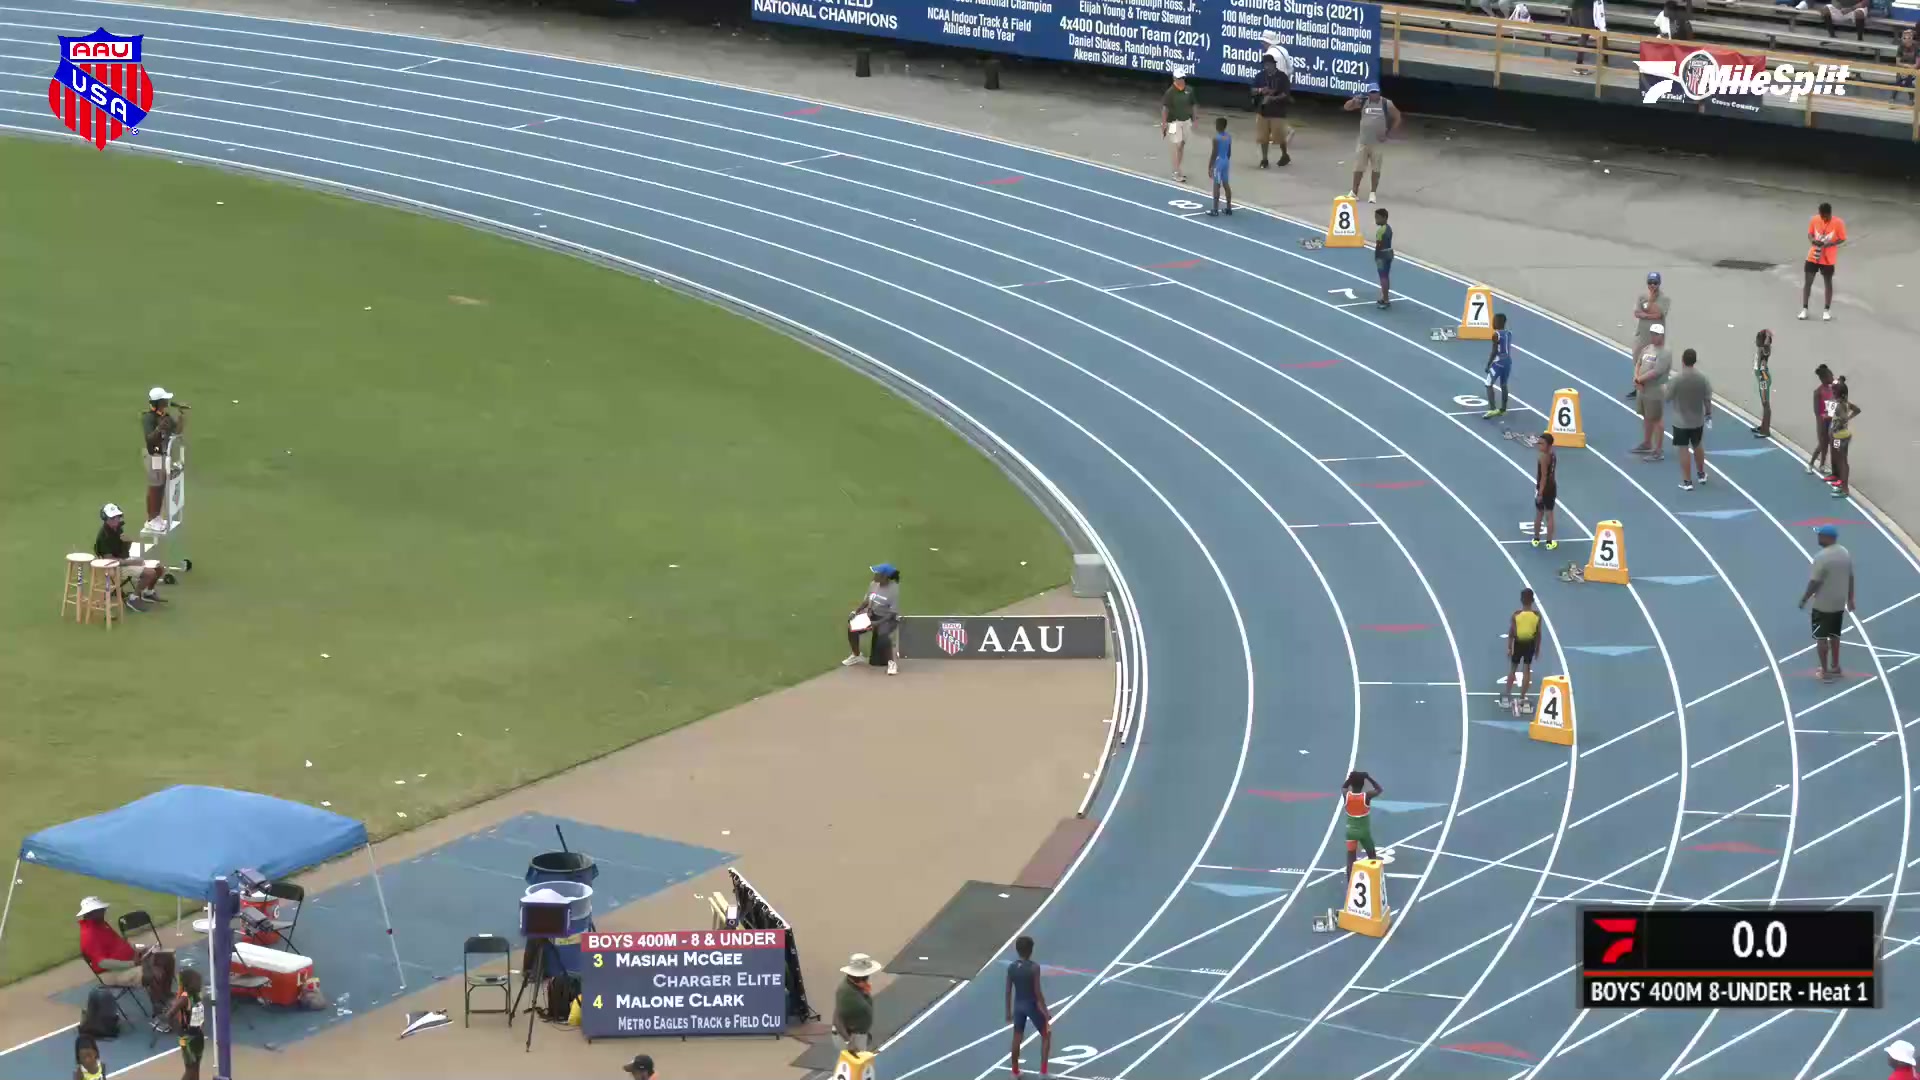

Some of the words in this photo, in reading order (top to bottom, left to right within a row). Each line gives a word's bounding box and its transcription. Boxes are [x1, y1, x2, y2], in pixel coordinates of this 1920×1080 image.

[754, 1, 816, 19] NATIONAL
[819, 7, 898, 29] CHAMPIONS
[1010, 0, 1052, 13] Champion
[1079, 1, 1101, 16] Elijah
[1102, 4, 1125, 20] Young
[1127, 7, 1134, 19] &
[1135, 8, 1160, 22] Trevor
[1162, 11, 1191, 26] Stewart
[1284, 0, 1324, 17] Sturgis
[1326, 3, 1364, 24] (2021)
[927, 7, 950, 21] NCAA
[951, 10, 977, 25] Indoor
[979, 14, 1000, 28] Track
[1002, 17, 1009, 29] &
[1011, 18, 1032, 32] Field
[1222, 10, 1237, 23] 100
[1239, 12, 1261, 26] Meter
[1263, 15, 1294, 30] Outdoor
[1296, 19, 1329, 34] National
[1331, 23, 1372, 40] Champion
[943, 22, 971, 36] Athlete
[972, 26, 981, 38] of
[982, 27, 995, 39] the
[997, 29, 1015, 42] Year
[1060, 16, 1092, 33] 4x400
[1095, 21, 1138, 38] Outdoor
[1140, 26, 1171, 43] Team
[1174, 30, 1211, 51] (2021)
[1221, 25, 1237, 38] 200
[1296, 34, 1329, 49] National
[1331, 38, 1371, 55] Champion
[1069, 33, 1093, 47] Daniel
[1095, 37, 1123, 53] Stokes,
[1125, 40, 1162, 57] Randolph
[1163, 45, 1185, 61] Ross,
[1073, 47, 1099, 62] Akeem
[1101, 51, 1127, 66] Sirleaf
[1131, 55, 1138, 67] &
[1140, 56, 1164, 70] Trevor
[1223, 45, 1262, 62] Randol
[1289, 55, 1309, 71] oss,
[1313, 56, 1328, 71] Jr.
[1332, 58, 1369, 79] (2021)
[1221, 63, 1236, 76] 400
[1295, 74, 1328, 88] National
[1711, 98, 1730, 107] Cross
[1731, 102, 1760, 112] Country
[1339, 211, 1350, 229] 8
[1328, 288, 1358, 299] 7
[1472, 302, 1484, 320] 7
[1453, 394, 1489, 407] 6
[1558, 407, 1571, 427] 6
[1600, 540, 1614, 561] 5
[978, 625, 1064, 652] AAU
[1544, 697, 1558, 720] 4
[1354, 882, 1366, 908] 3
[588, 935, 633, 949] BOYS
[637, 933, 676, 947] 400M
[692, 933, 699, 947] 8
[704, 933, 715, 946] &
[720, 932, 776, 946] UNDER
[593, 953, 603, 968] 3
[616, 953, 678, 968] MASIAH
[652, 974, 731, 988] CHARGER
[737, 972, 781, 986] ELITE
[593, 995, 603, 1009] 4
[616, 994, 684, 1009] MALONE
[689, 993, 745, 1007] CLARK
[618, 1016, 651, 1031] METRO
[653, 1016, 688, 1030] EAGLES
[690, 1015, 723, 1029] TRACK
[724, 1017, 731, 1029] &
[734, 1014, 759, 1028] FIELD
[761, 1013, 781, 1027] CLU
